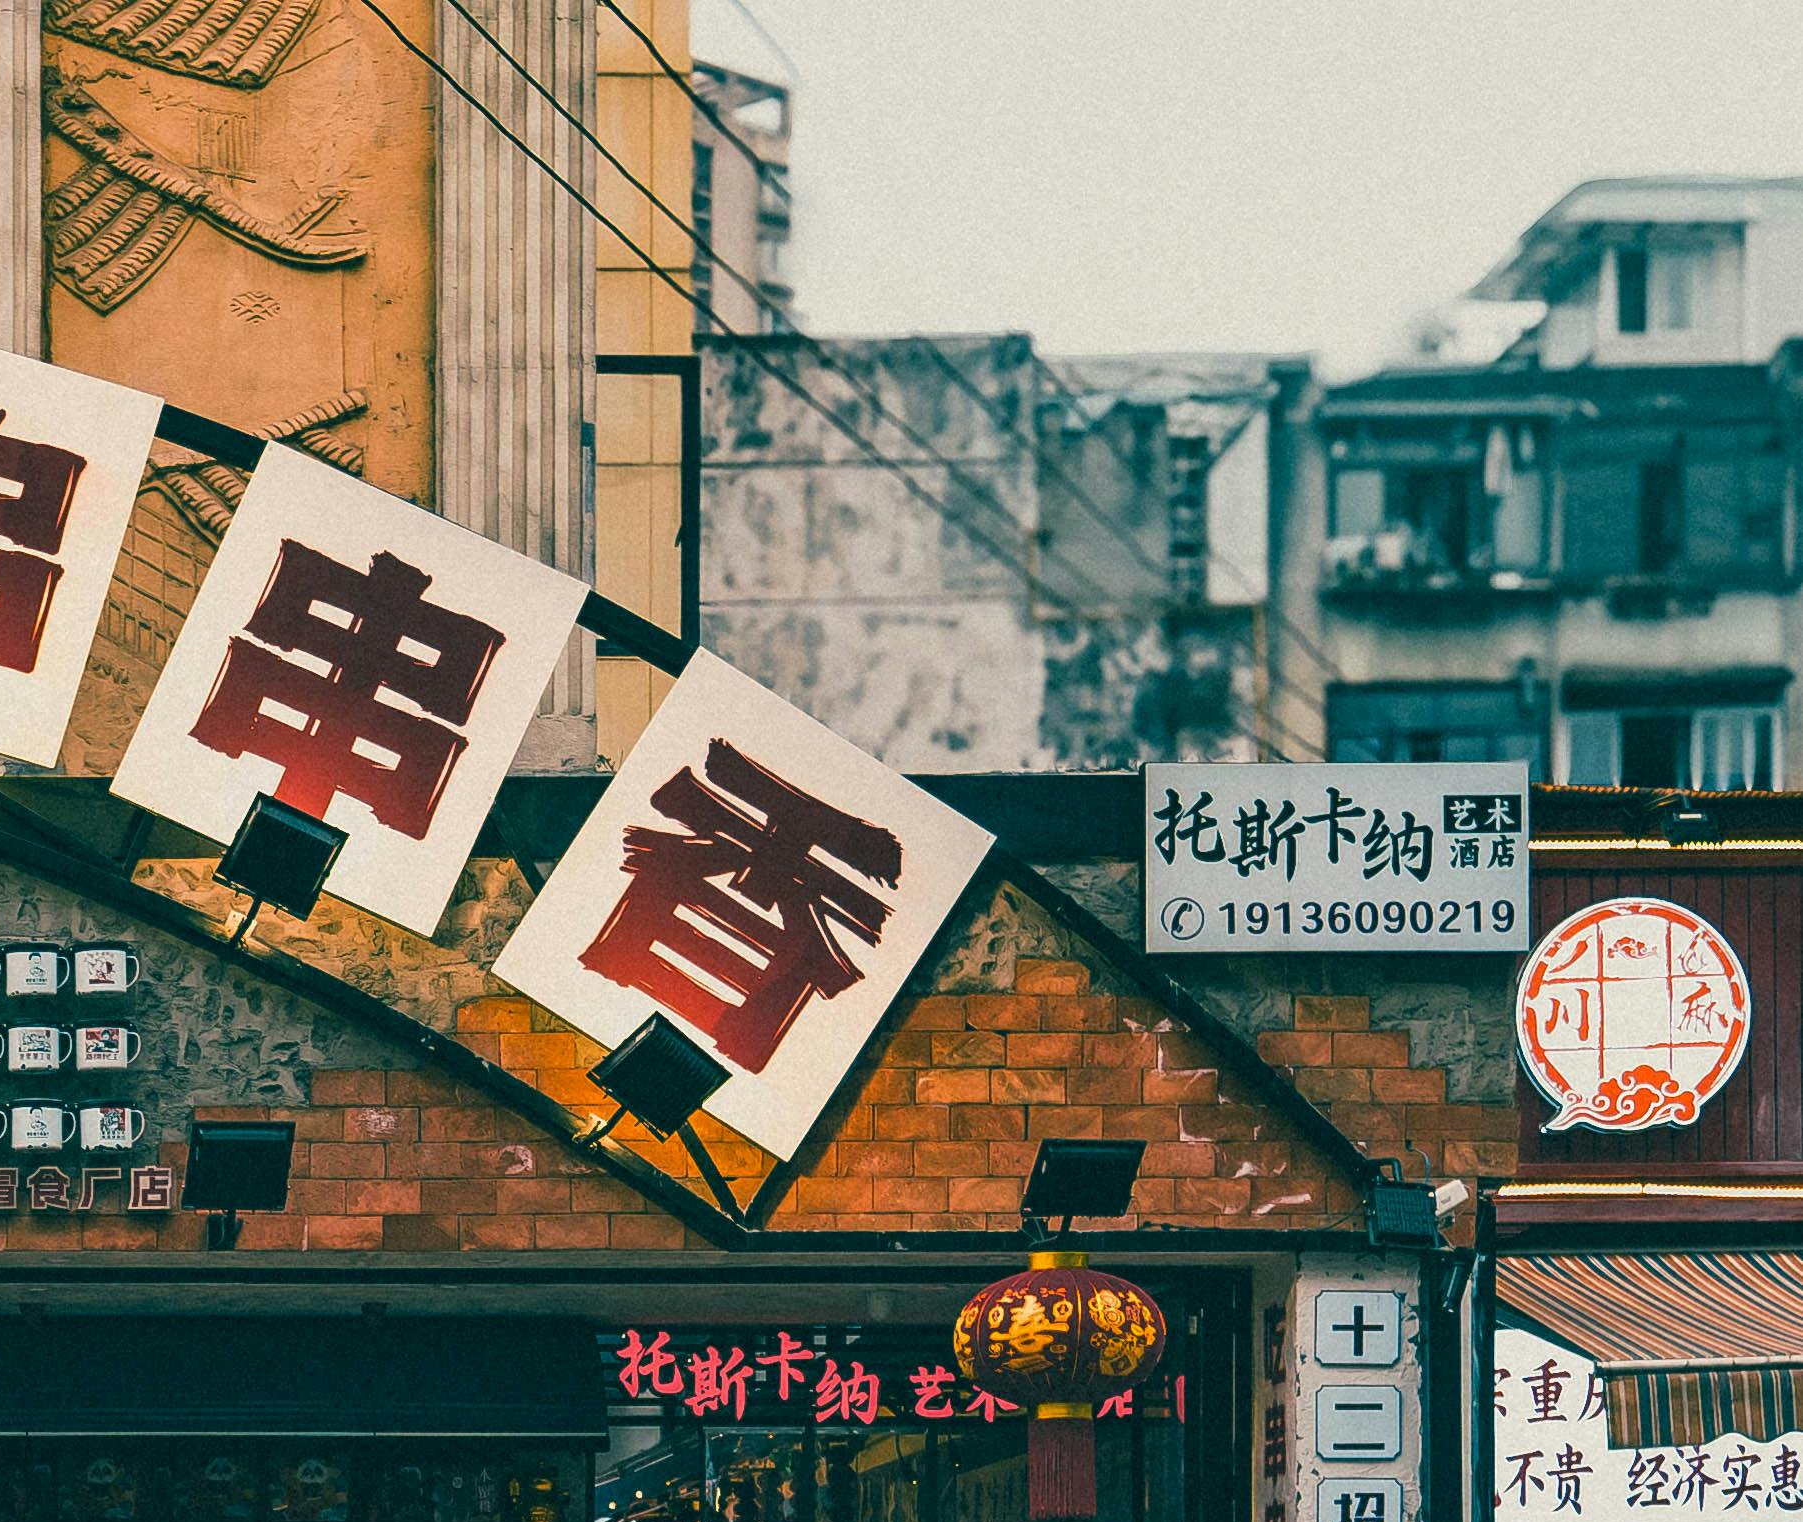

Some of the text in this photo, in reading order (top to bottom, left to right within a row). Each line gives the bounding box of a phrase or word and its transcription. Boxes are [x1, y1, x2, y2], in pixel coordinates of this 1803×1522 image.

[1154, 787, 1516, 883] 托斯卡纳 艺术
[1450, 838, 1516, 869] 酒店
[1219, 898, 1516, 936] 19136090219
[1546, 989, 1589, 1041] 川
[616, 1330, 880, 1425] 托斯卡纳
[1495, 1443, 1803, 1515] 不贵 经济实惠
